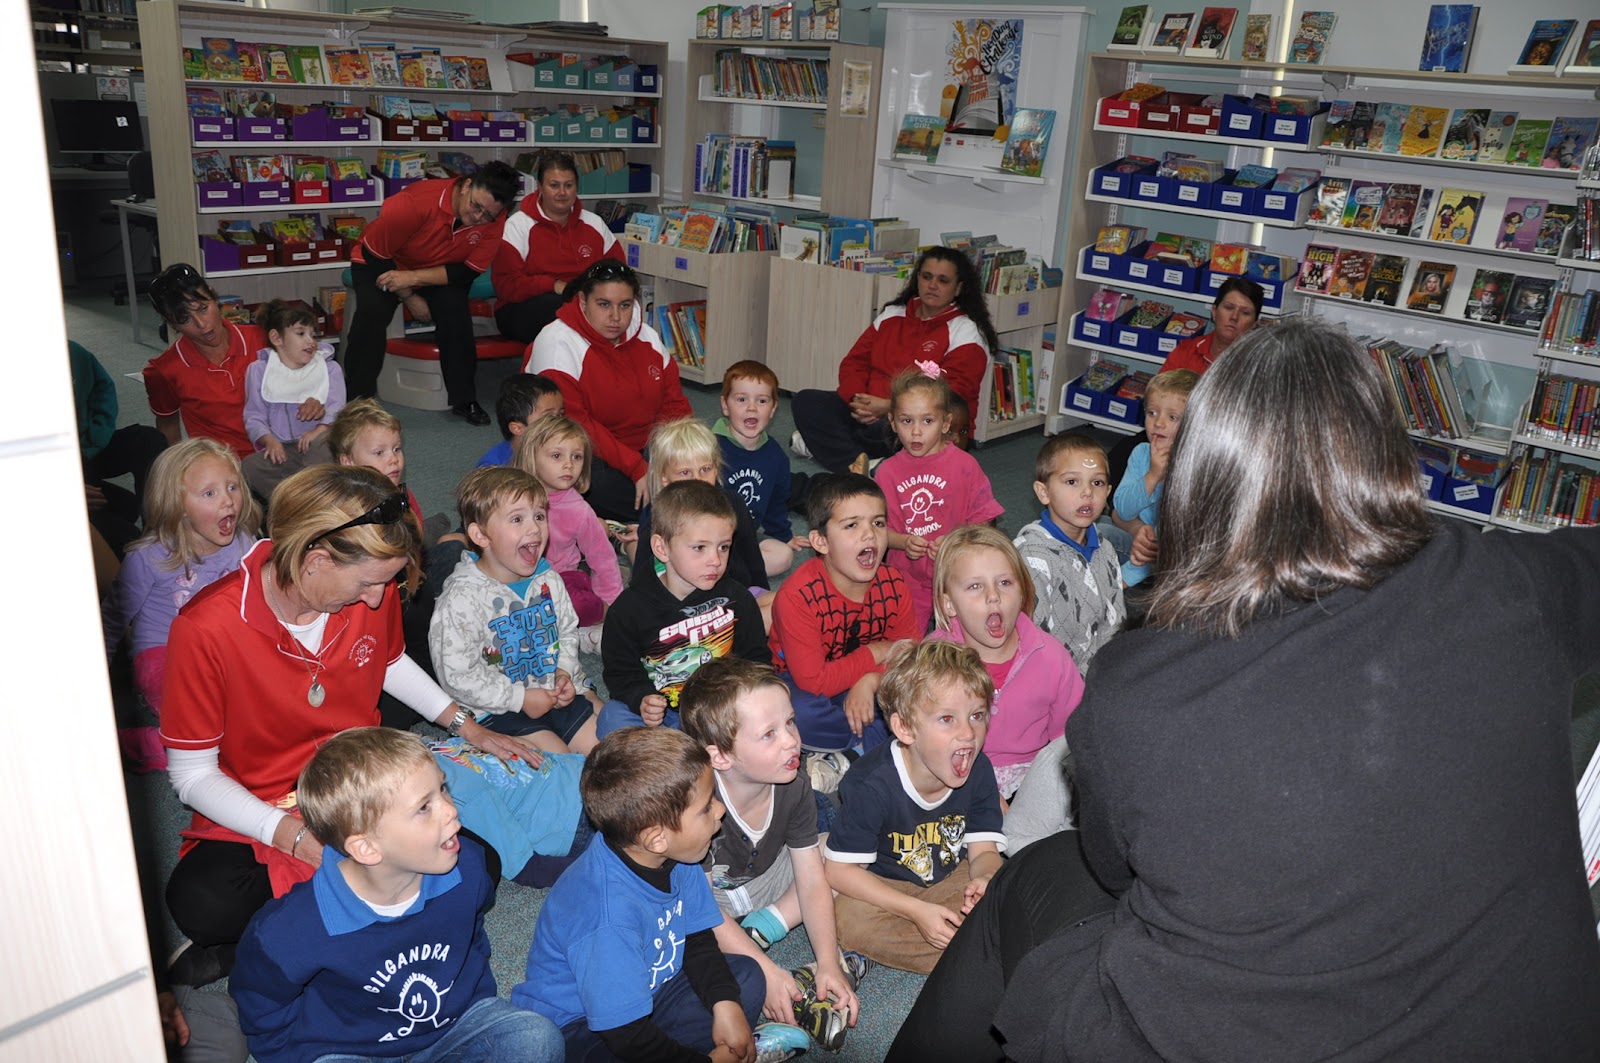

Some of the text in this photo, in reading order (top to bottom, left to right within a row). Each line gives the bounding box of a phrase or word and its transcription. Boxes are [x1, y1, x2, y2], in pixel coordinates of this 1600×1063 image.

[1202, 33, 1223, 41] WIND
[909, 116, 940, 124] STOLEN
[1307, 251, 1334, 262] HIGH
[897, 474, 947, 493] GILGANDRA
[363, 943, 450, 994] GILGANDRA
